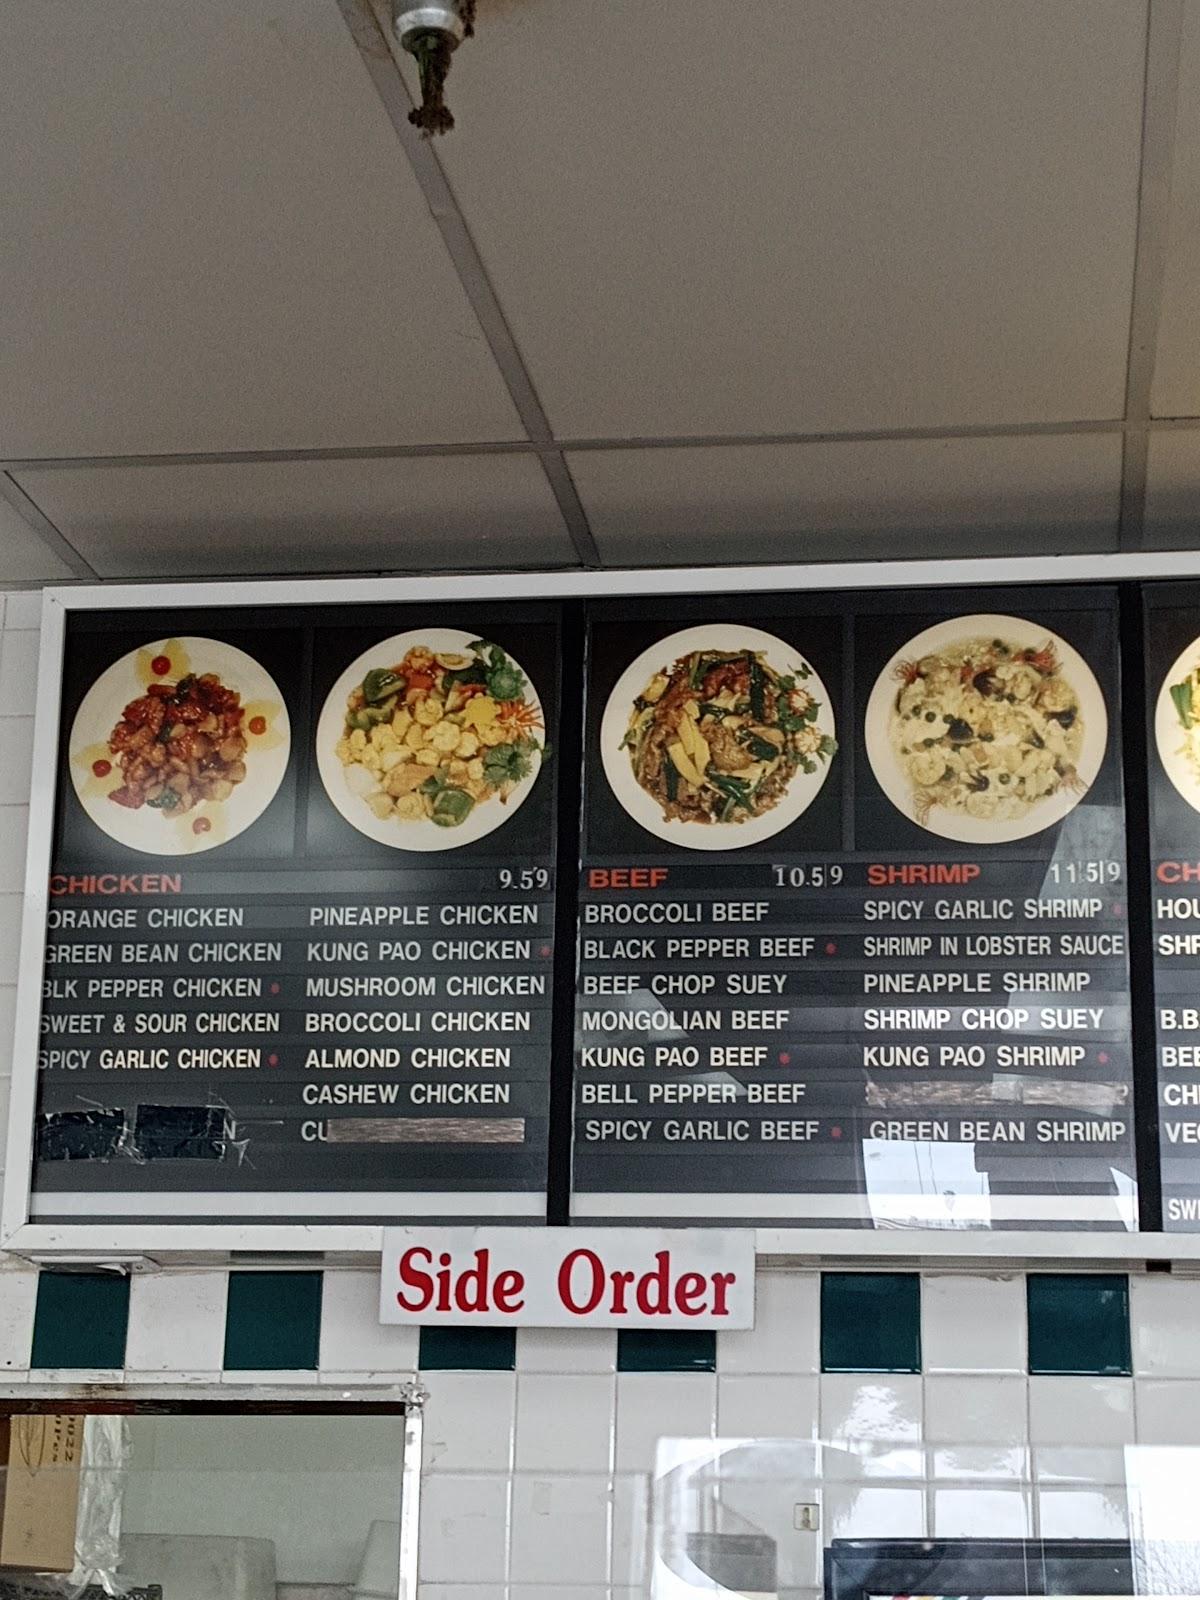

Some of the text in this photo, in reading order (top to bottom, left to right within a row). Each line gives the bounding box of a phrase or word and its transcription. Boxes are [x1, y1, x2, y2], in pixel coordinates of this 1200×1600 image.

[50, 873, 182, 895] CHICKEN
[499, 868, 548, 889] 9.59
[588, 868, 669, 889] BEEF
[775, 865, 844, 888] 10.59
[867, 865, 981, 885] SHRIMP
[47, 908, 243, 928] ORANGE CHICKEN
[309, 905, 538, 926] PINEAPPLE CHICKEN
[585, 902, 770, 924] BROCCOLI BEEF
[863, 899, 1103, 921] SPICY GARLIC SHRIMP
[45, 942, 282, 963] GREEN BEAN CHICKEN
[307, 940, 531, 961] KUNG PAO CHICKEN
[584, 938, 815, 959] BLACK PEPPER BEEF
[863, 935, 1124, 957] SHRIMP IN LOBSTER SAUCE
[87, 979, 164, 998] PEPPER
[173, 978, 261, 998] CHICKEN
[306, 976, 545, 997] MUSHROOM CHICKEN
[583, 974, 787, 995] BEEF CHOP SUEY
[863, 972, 1091, 993] PINEAPPLE SHRIMP
[39, 1013, 280, 1033] SWEET & SOUR CHICKEN
[305, 1011, 531, 1033] BROCCOLI CHICKEN
[582, 1010, 790, 1031] MONGOLIAN BEEF
[863, 1008, 1104, 1030] SHRIMP CHOP SUEY
[38, 1049, 261, 1069] SPICY GARLIC CHICKEN
[305, 1048, 511, 1069] ALMOND CHICKEN
[581, 1047, 768, 1067] KUNG PAO BEEF
[863, 1045, 1086, 1067] KUNG PAO SHRIMP
[302, 1083, 510, 1105] CASHEW CHICKEN
[581, 1084, 806, 1104] BELL PEPPER BEEF
[585, 1120, 820, 1141] SPICY GARLIC BEEF
[869, 1120, 1126, 1142] GREEN BEAN SHRIMP
[397, 1246, 736, 1316] Side Order
